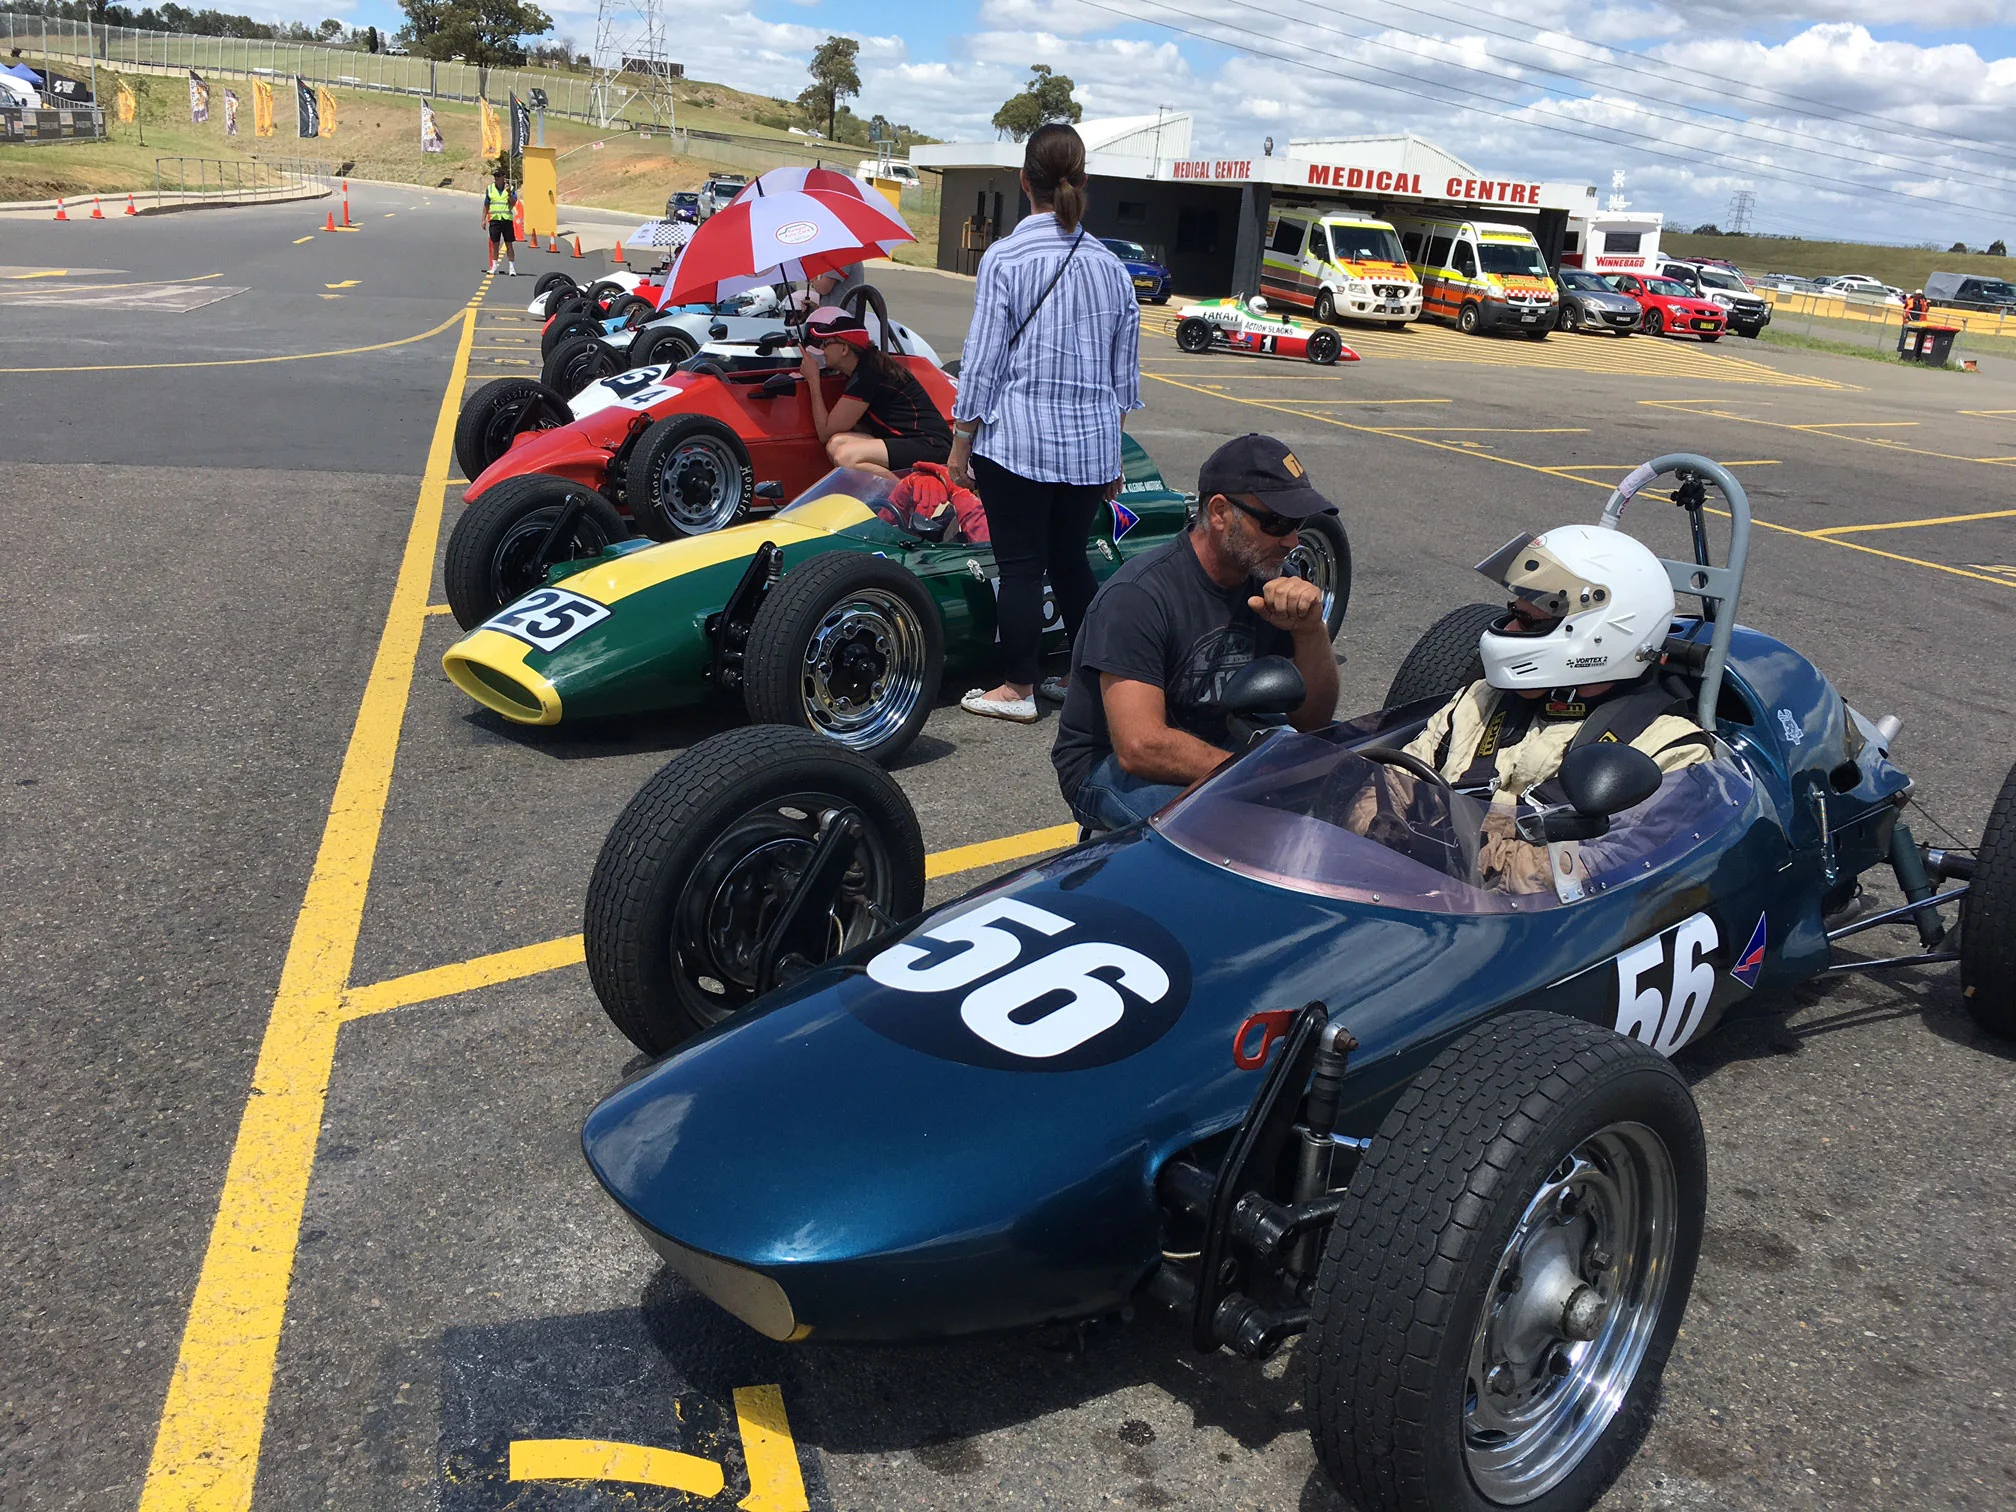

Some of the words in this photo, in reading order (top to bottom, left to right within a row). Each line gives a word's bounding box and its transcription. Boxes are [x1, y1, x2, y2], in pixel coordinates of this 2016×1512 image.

[1173, 161, 1210, 179] MEDICAL
[1215, 160, 1252, 179] CENTRE
[1308, 164, 1423, 195] MEDICAL
[1446, 177, 1542, 205] CENTRE
[1595, 256, 1646, 268] WINNEBAGO
[1244, 321, 1267, 333] ACTION
[1261, 335, 1273, 353] 1
[492, 591, 598, 639] 25
[1575, 656, 1603, 664] VORTEX
[866, 896, 1171, 1058] 56
[1614, 911, 1719, 1059] 56
